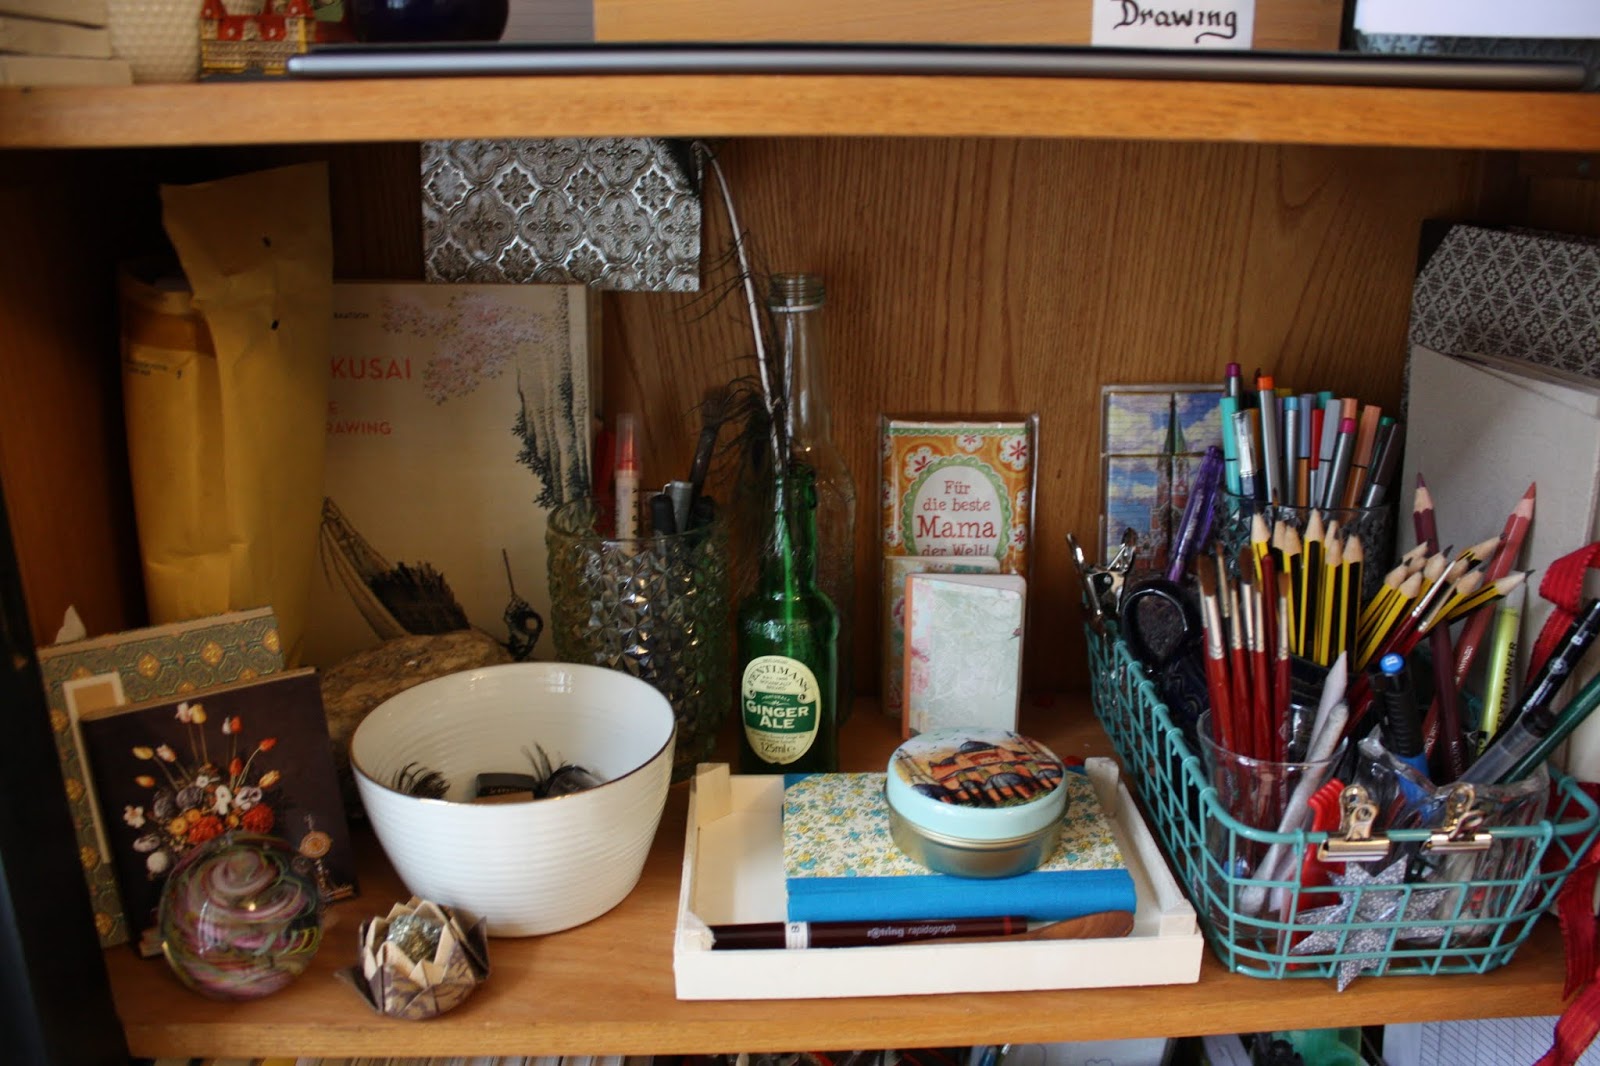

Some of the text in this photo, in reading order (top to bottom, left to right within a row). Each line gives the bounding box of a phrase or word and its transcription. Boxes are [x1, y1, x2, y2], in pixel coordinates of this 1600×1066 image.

[1112, 0, 1237, 45] Drawing
[330, 357, 411, 380] KUSAI
[944, 481, 971, 494] Für
[922, 498, 991, 511] die beste
[916, 515, 996, 538] Mama
[921, 543, 947, 556] der
[746, 700, 810, 718] GINGER
[759, 715, 795, 729] ALE
[907, 923, 957, 936] rapidograph
